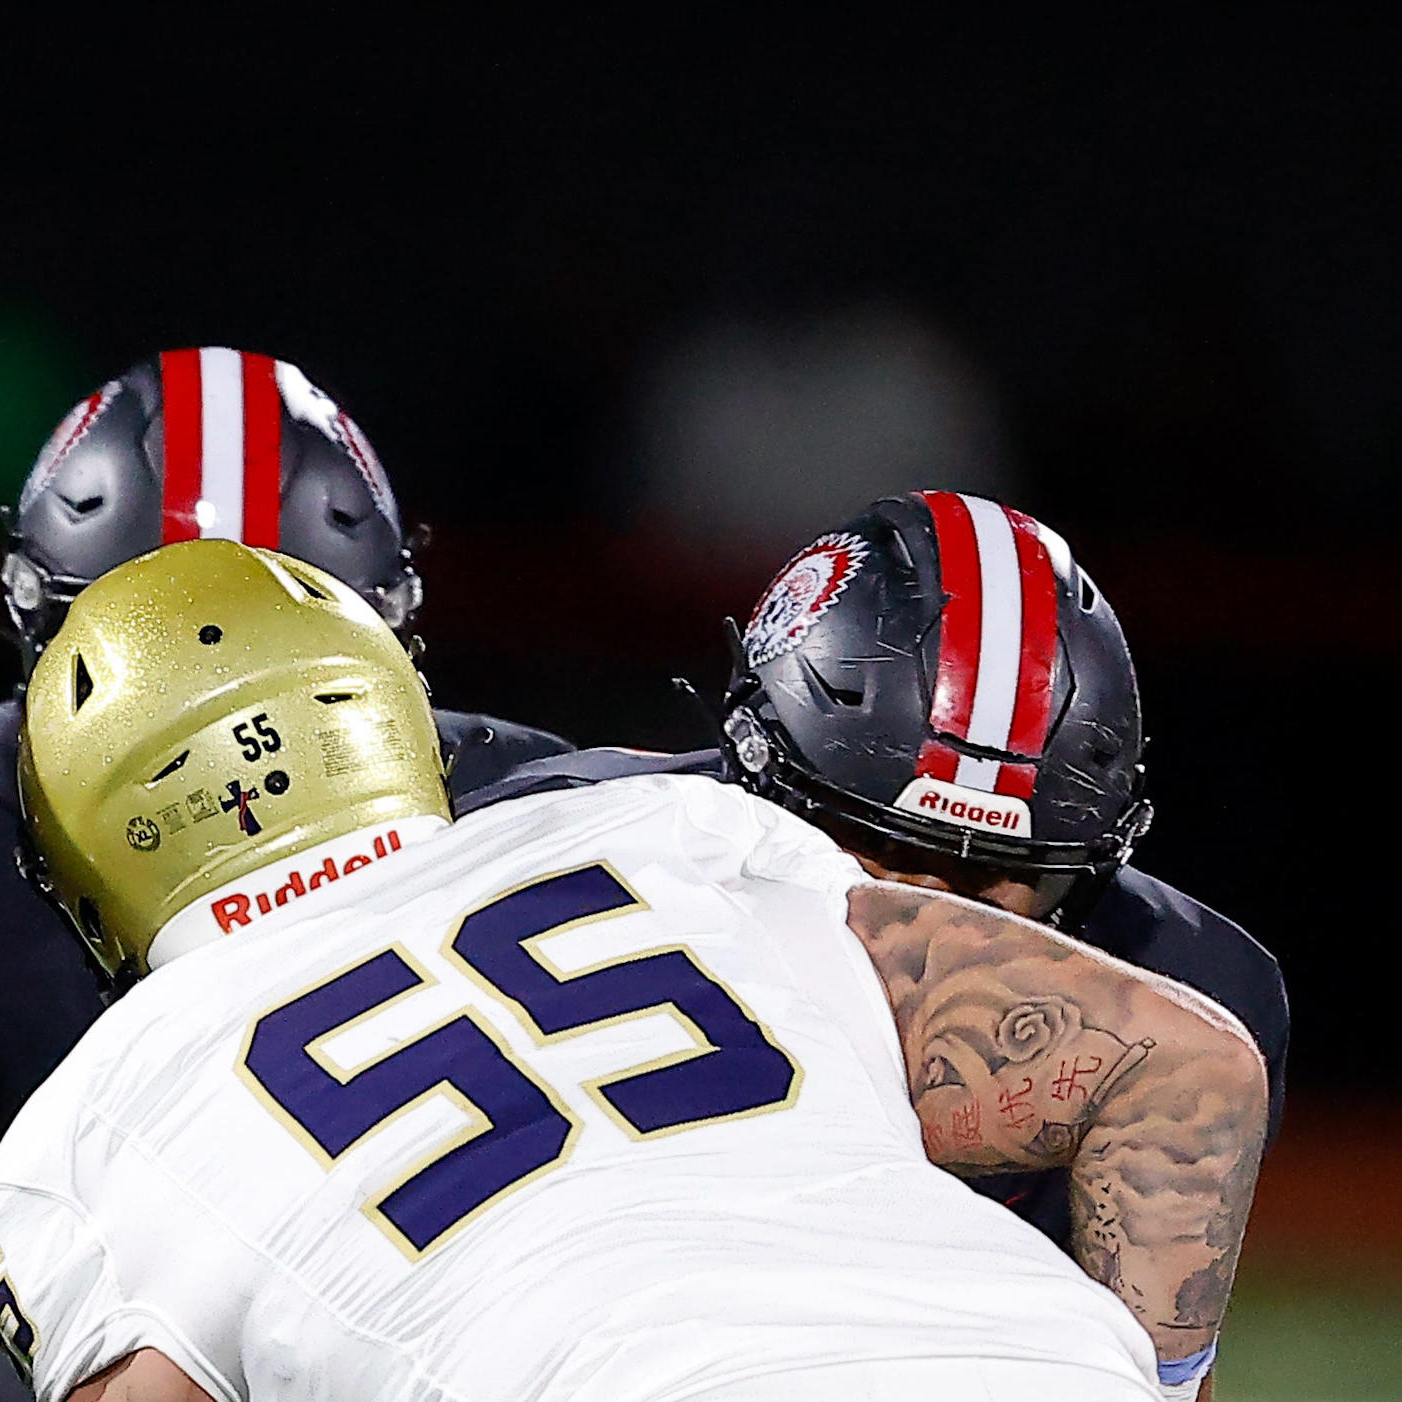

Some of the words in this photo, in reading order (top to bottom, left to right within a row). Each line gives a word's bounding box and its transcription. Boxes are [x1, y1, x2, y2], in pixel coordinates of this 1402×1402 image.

[232, 712, 282, 763] 55
[919, 790, 1020, 830] Riddell
[211, 829, 403, 935] Riddell
[232, 858, 806, 1264] 55
